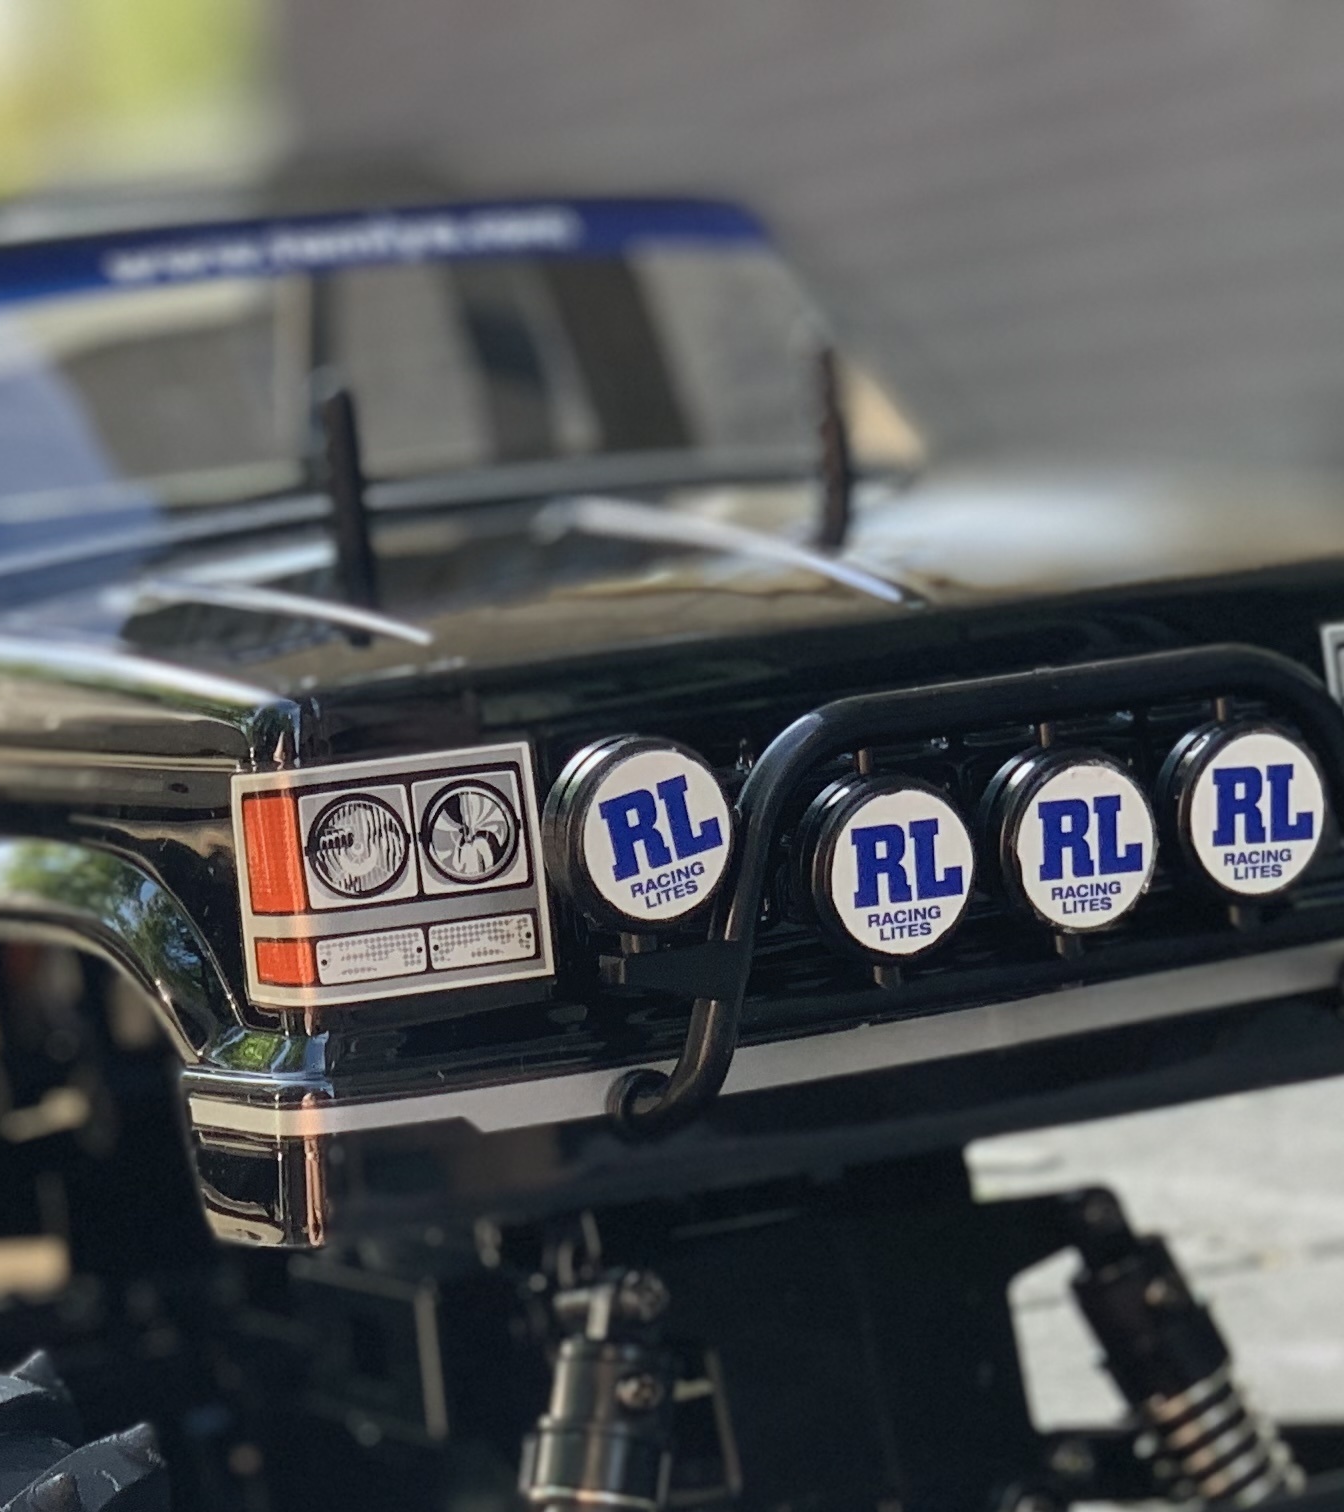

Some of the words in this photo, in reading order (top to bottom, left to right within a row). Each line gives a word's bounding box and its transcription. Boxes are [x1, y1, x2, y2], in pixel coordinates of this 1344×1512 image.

[1213, 764, 1313, 847] RL
[598, 774, 723, 882] RL
[1038, 795, 1143, 881] RL
[851, 818, 963, 909] RL
[1223, 849, 1292, 866] RACING
[630, 861, 705, 898] RACING
[1234, 865, 1283, 880] LITES
[644, 880, 698, 909] LITES
[1051, 881, 1121, 900] RACING
[867, 905, 941, 928] RACING
[1062, 897, 1112, 914] LITES
[879, 923, 932, 941] LITES
